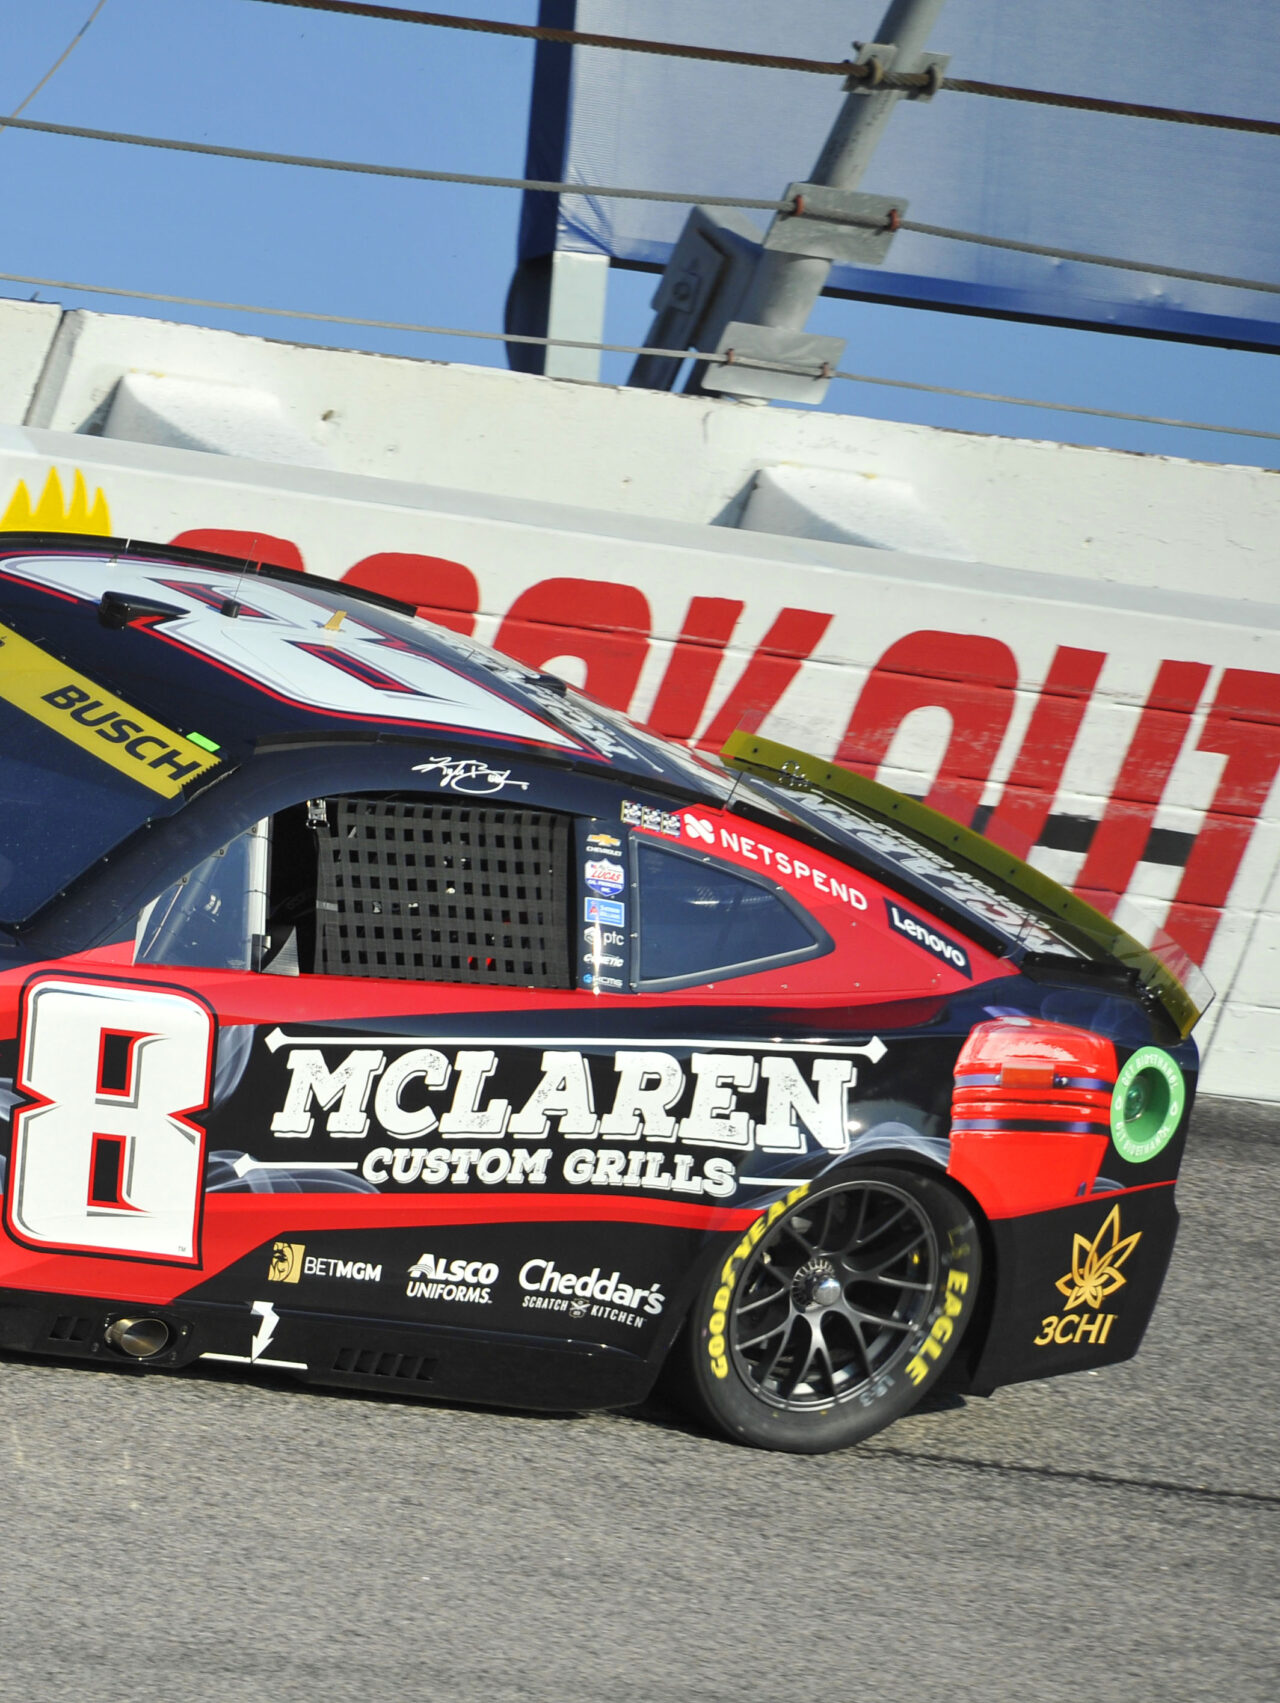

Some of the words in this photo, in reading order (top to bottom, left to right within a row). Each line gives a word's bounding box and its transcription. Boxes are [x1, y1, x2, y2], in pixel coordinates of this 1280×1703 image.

[40, 684, 203, 781] BUSCH
[591, 870, 621, 882] LUCAS
[721, 828, 868, 911] NETSPEND
[603, 931, 625, 946] ptc
[892, 907, 966, 967] Lenovo
[8, 975, 213, 1264] 8
[271, 1048, 857, 1154] MCLAREN
[362, 1146, 551, 1185] CUSTOM
[563, 1149, 741, 1198] GRILLS
[304, 1256, 383, 1283] BETMGM
[406, 1281, 491, 1304] UNIFORMS
[407, 1253, 500, 1285] ALSCO
[518, 1258, 666, 1316] Cheddar's
[522, 1295, 569, 1312] SCRATCH
[590, 1304, 645, 1329] KITCHEN
[905, 1268, 969, 1386] EAGLE
[1032, 1313, 1115, 1346] 3CHI
